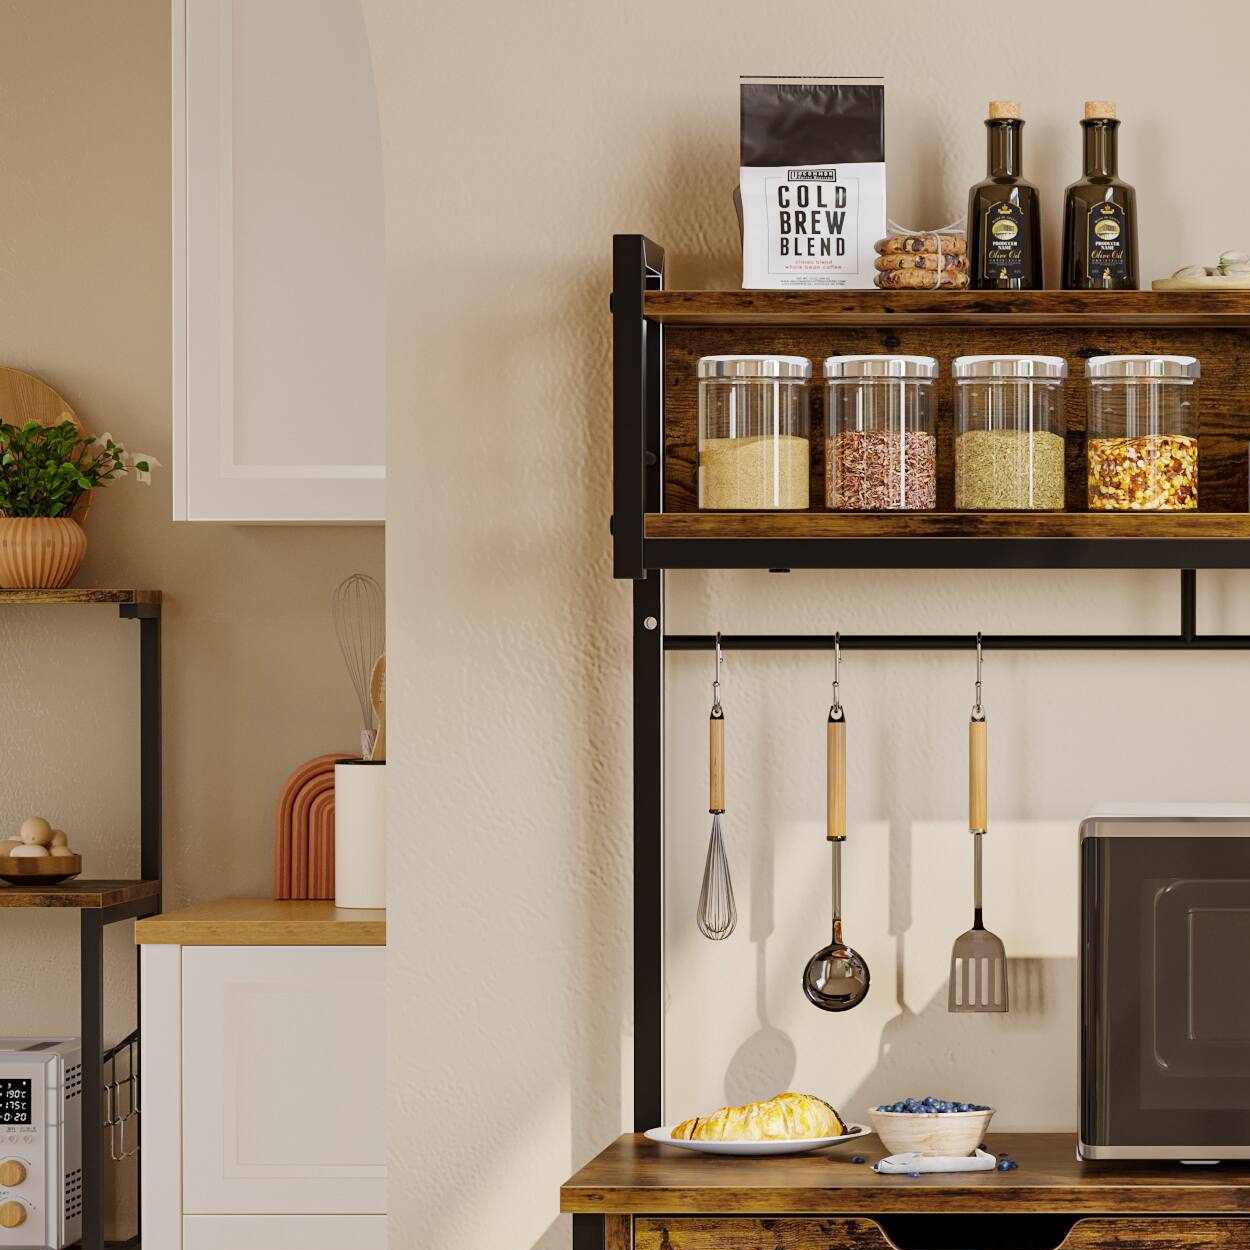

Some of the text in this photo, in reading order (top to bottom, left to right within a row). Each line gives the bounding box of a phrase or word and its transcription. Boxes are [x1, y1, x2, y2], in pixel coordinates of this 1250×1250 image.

[778, 185, 847, 208] COLD
[780, 210, 846, 234] BREW
[780, 237, 845, 256] BLEND
[988, 250, 1022, 258] Olive Oil
[1091, 250, 1124, 258] Olive Oil
